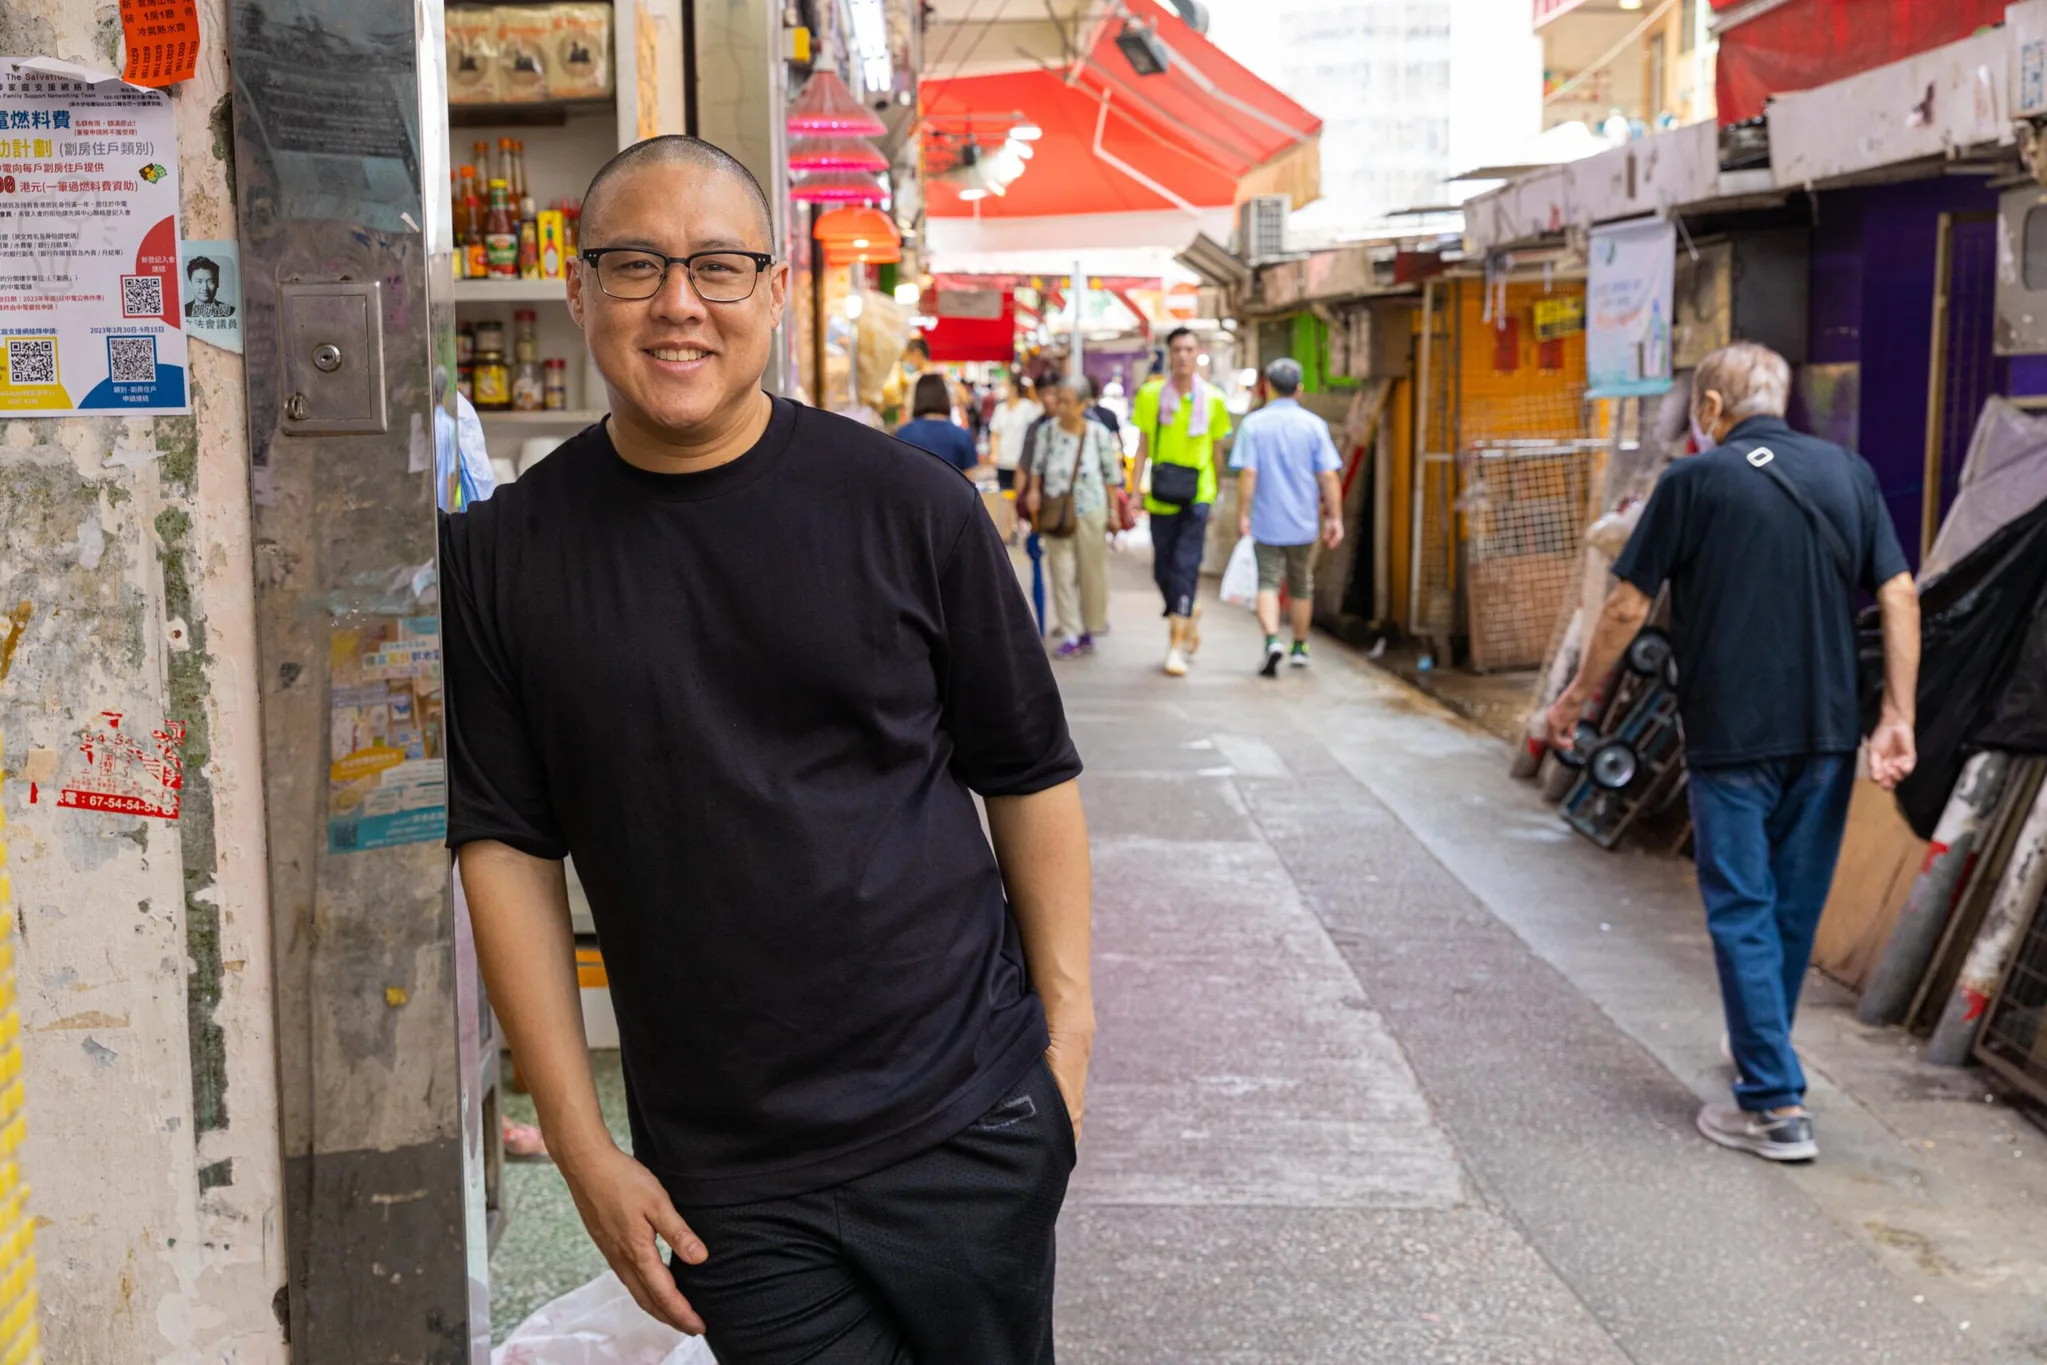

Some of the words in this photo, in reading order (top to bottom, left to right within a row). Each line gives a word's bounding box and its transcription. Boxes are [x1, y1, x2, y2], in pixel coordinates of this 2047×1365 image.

[0, 83, 95, 92] 家庭支援網絡隊
